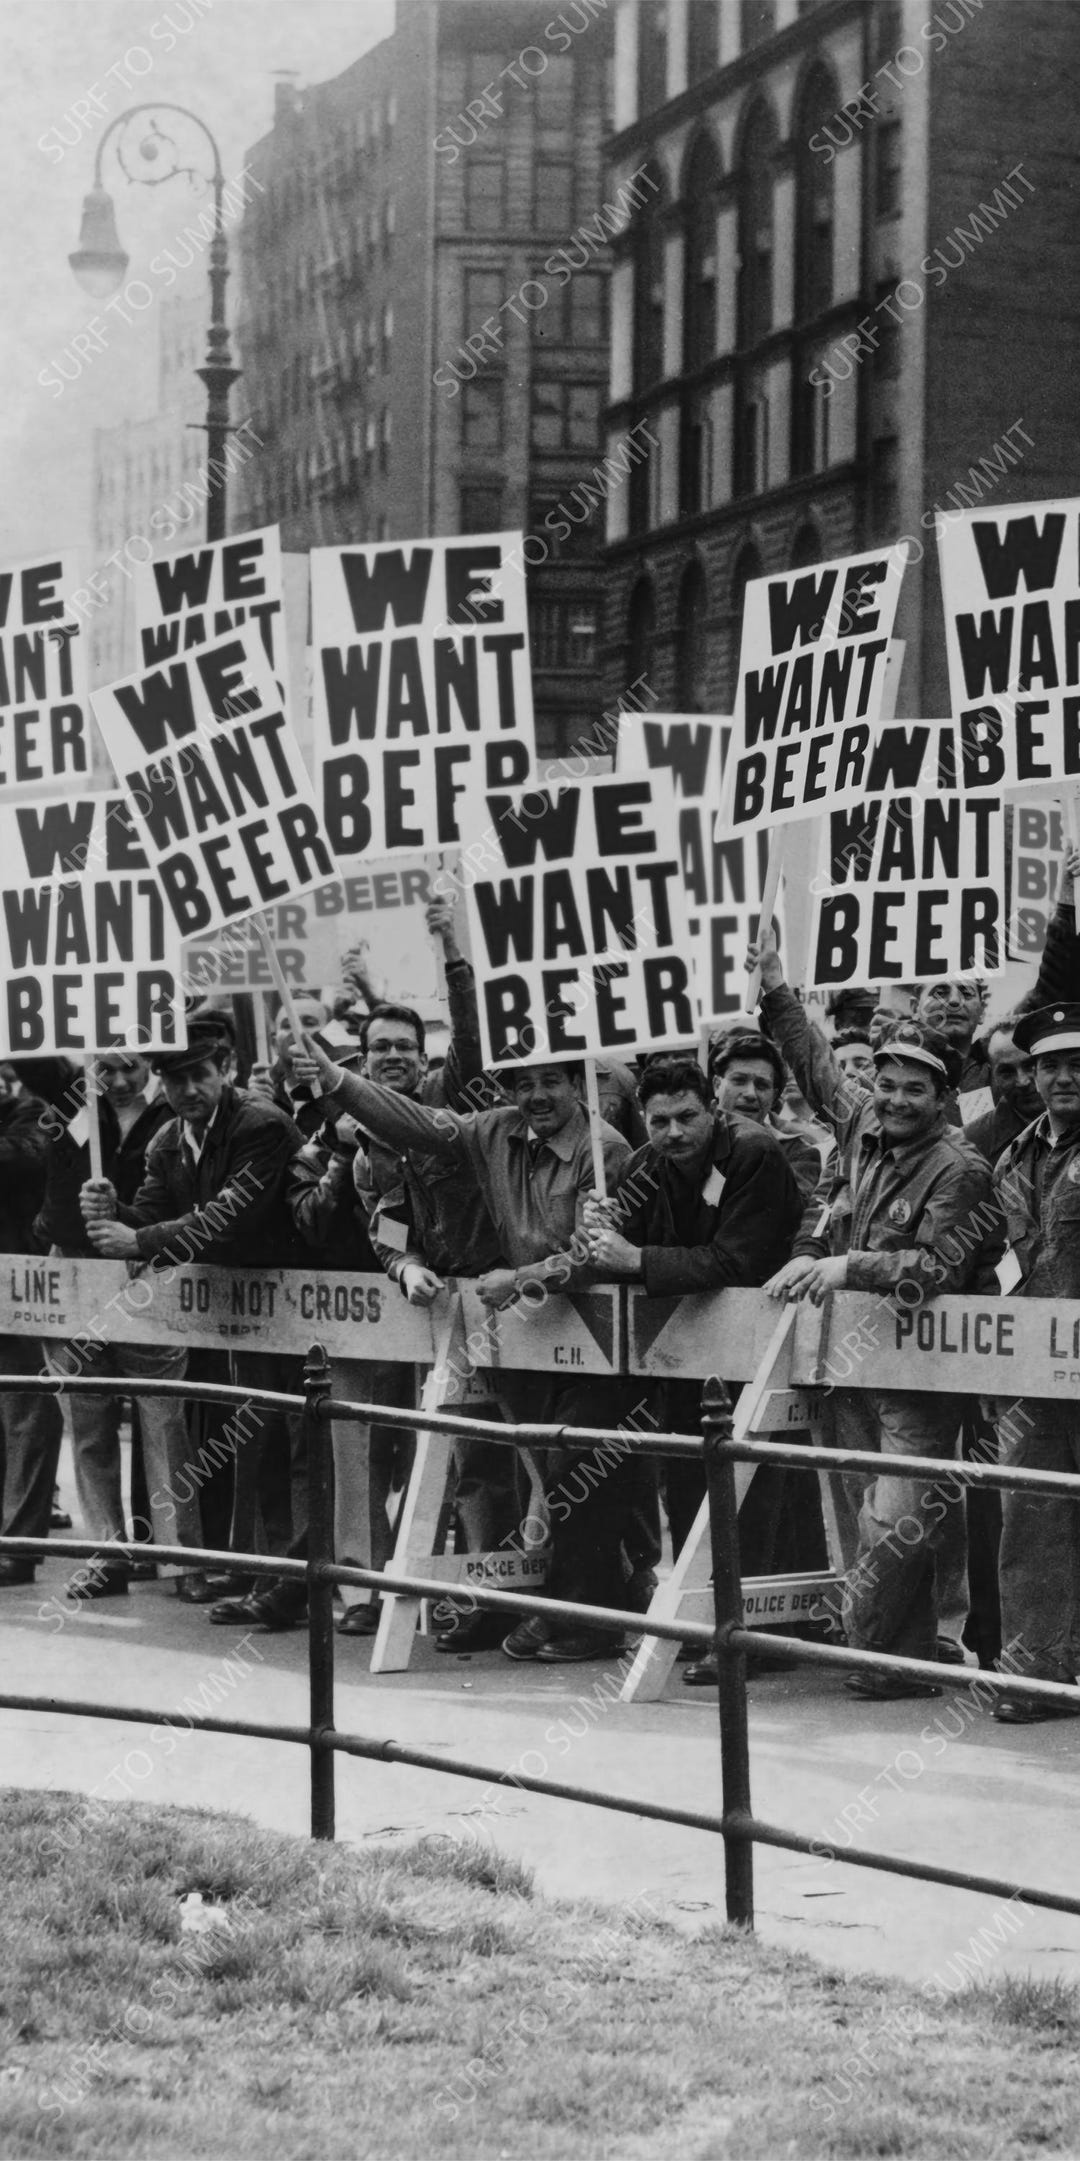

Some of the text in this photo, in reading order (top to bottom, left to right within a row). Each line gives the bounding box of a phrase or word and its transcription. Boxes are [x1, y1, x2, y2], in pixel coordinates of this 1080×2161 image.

[0, 561, 64, 629] E
[153, 538, 266, 616] WE
[341, 546, 504, 633] WE
[769, 560, 889, 656] WE
[113, 640, 263, 755] WE
[321, 633, 525, 746] WANT
[745, 638, 888, 748] WANT
[125, 711, 298, 851] WANT
[643, 721, 732, 798] W
[733, 723, 870, 826] BEER
[16, 801, 150, 878] WE
[486, 781, 657, 869] WE
[830, 797, 1000, 886] WANT
[158, 803, 335, 937] BEER
[314, 869, 432, 917] BEER
[474, 861, 679, 969] WANT
[814, 886, 1000, 985] BEER
[7, 969, 176, 1052] BEER
[484, 956, 695, 1062] BEER
[11, 1269, 381, 1324] LINE DO NOT CROSS
[14, 1311, 67, 1325] POLICE
[896, 1309, 1015, 1356] POLICE
[743, 1594, 786, 1614] OLICE
